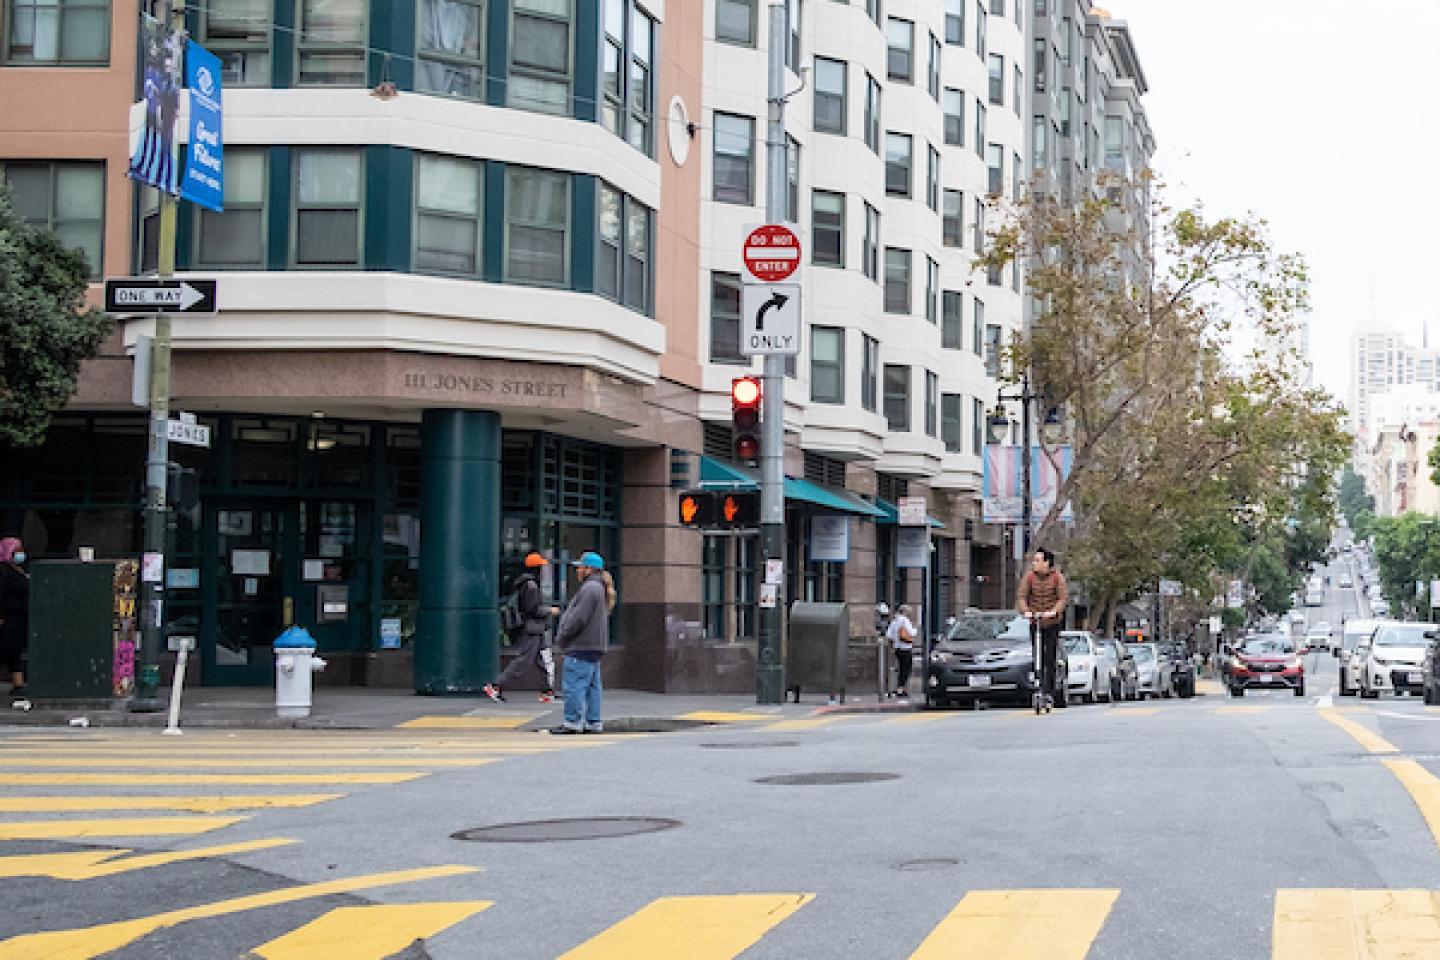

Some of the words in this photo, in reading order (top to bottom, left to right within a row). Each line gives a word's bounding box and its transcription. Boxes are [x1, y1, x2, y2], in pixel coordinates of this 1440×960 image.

[750, 234, 767, 246] DO
[772, 234, 793, 246] NOT
[755, 261, 789, 272] ENTER
[119, 289, 145, 301] ONE
[155, 290, 182, 301] WAY
[750, 335, 793, 349] ONLY
[434, 374, 494, 393] JONES
[501, 378, 567, 398] STREET
[170, 423, 205, 442] JONES
